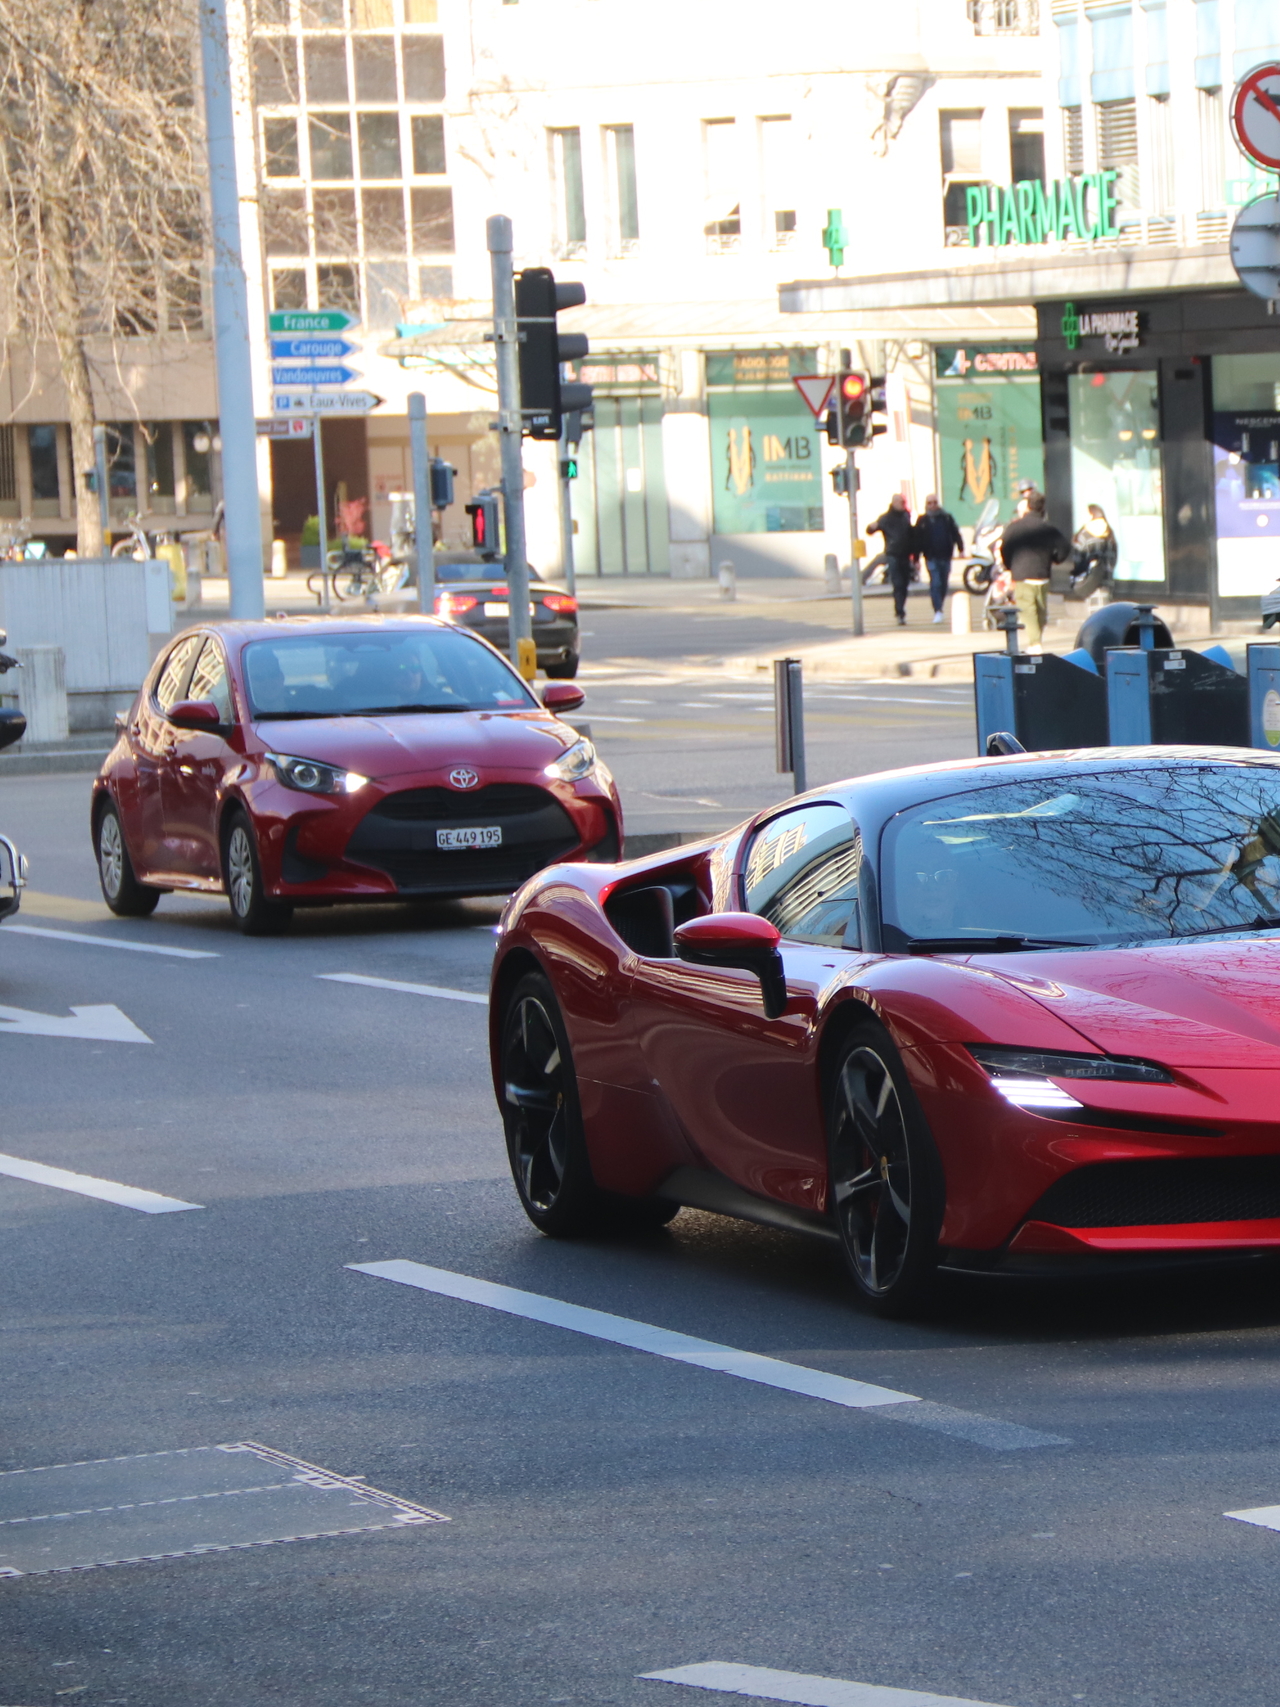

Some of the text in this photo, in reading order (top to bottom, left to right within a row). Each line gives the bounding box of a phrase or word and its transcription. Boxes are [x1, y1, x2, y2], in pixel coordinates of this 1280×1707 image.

[966, 171, 1120, 248] PHARMACIE
[283, 315, 330, 329] France
[1079, 311, 1138, 335] LA PHARMACIE
[291, 341, 342, 356] Carouge
[974, 352, 1037, 371] CENTRE
[274, 367, 342, 383] Vandoeuvres
[310, 395, 366, 408] Eaux-Vives
[763, 435, 811, 461] IMB
[480, 829, 500, 843] 195
